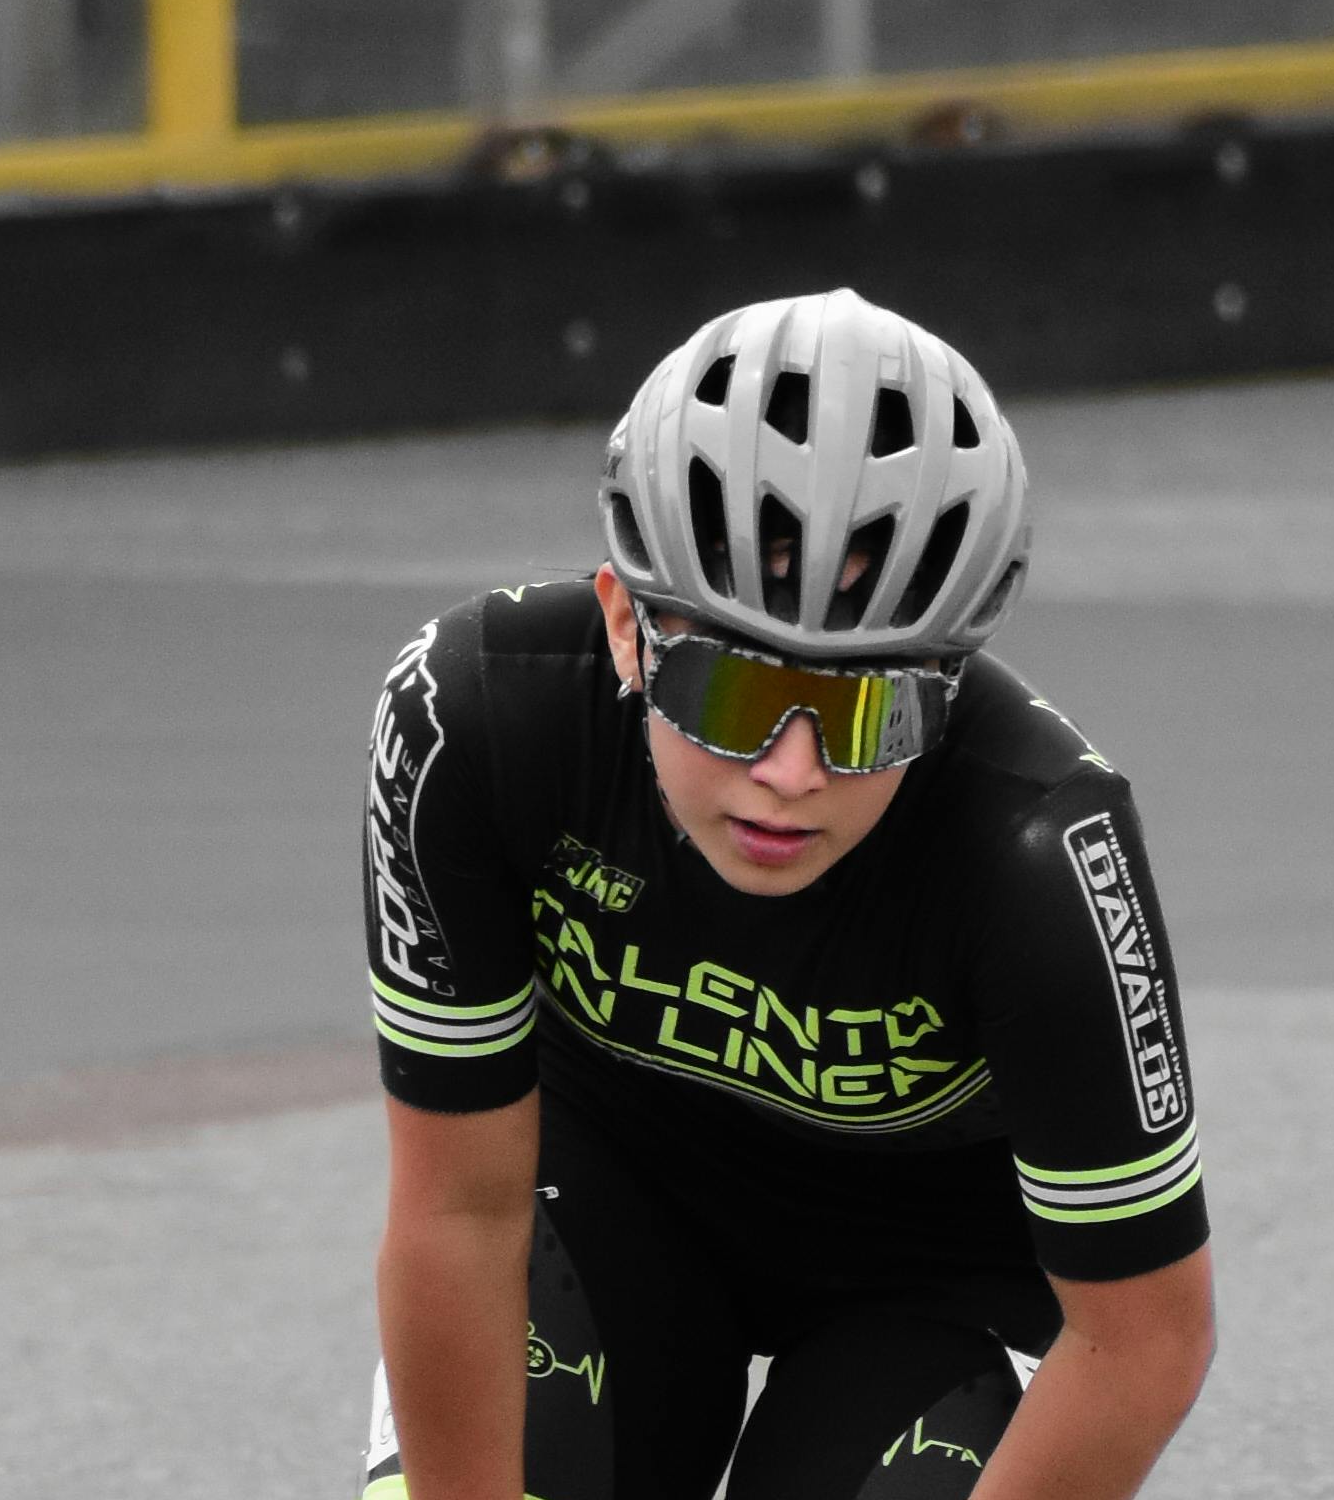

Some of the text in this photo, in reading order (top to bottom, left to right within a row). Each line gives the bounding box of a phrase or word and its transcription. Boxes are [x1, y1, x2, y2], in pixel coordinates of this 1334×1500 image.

[392, 749, 456, 997] CAMPIONE
[531, 889, 945, 1057] TALENTO
[658, 1005, 959, 1105] LINEA
[1079, 836, 1179, 1123] DAVALOS
